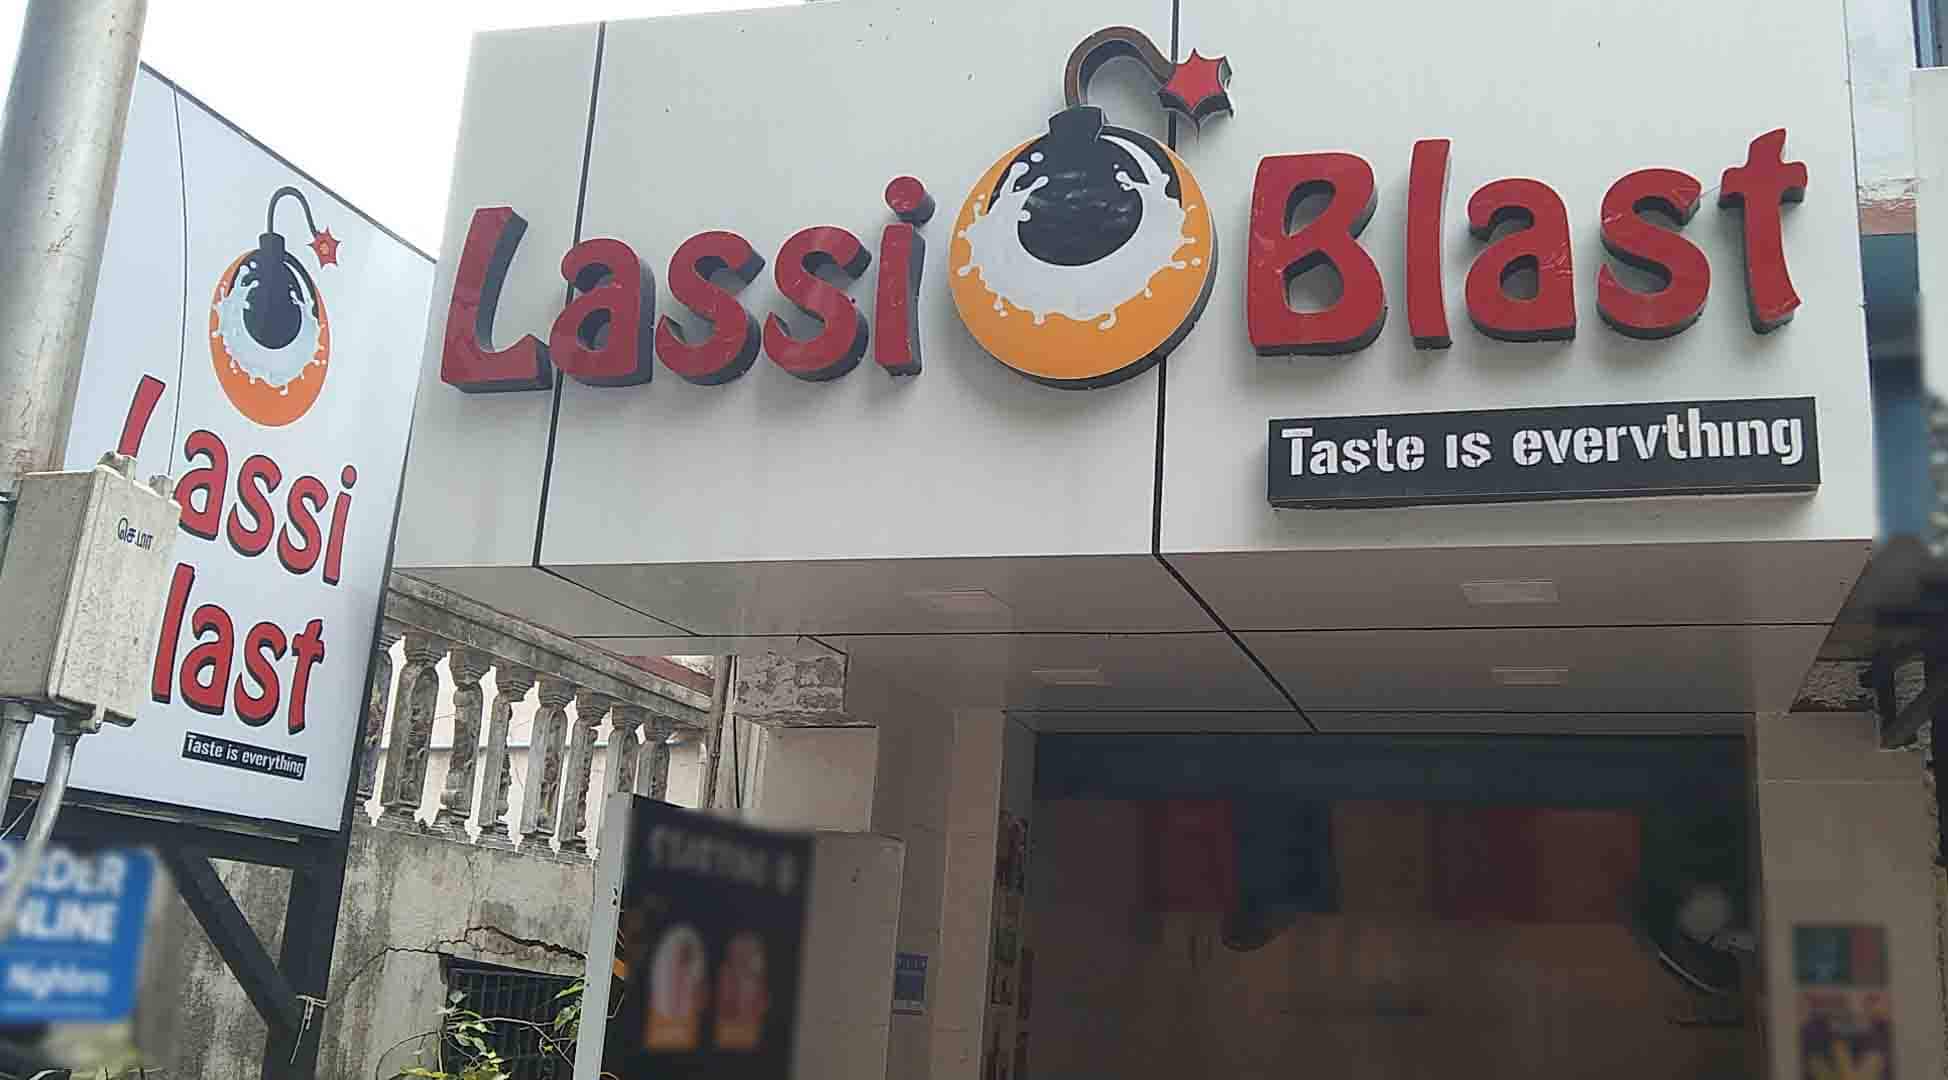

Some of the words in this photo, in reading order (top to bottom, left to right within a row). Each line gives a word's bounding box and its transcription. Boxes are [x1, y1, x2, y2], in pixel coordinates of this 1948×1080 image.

[440, 175, 935, 393] Lassi
[1247, 128, 1808, 356] Blast
[1281, 427, 1425, 476] Taste
[1446, 432, 1491, 469] is
[152, 562, 325, 736] last
[187, 734, 223, 758] Taste
[226, 743, 239, 761] is
[241, 750, 305, 778] everything
